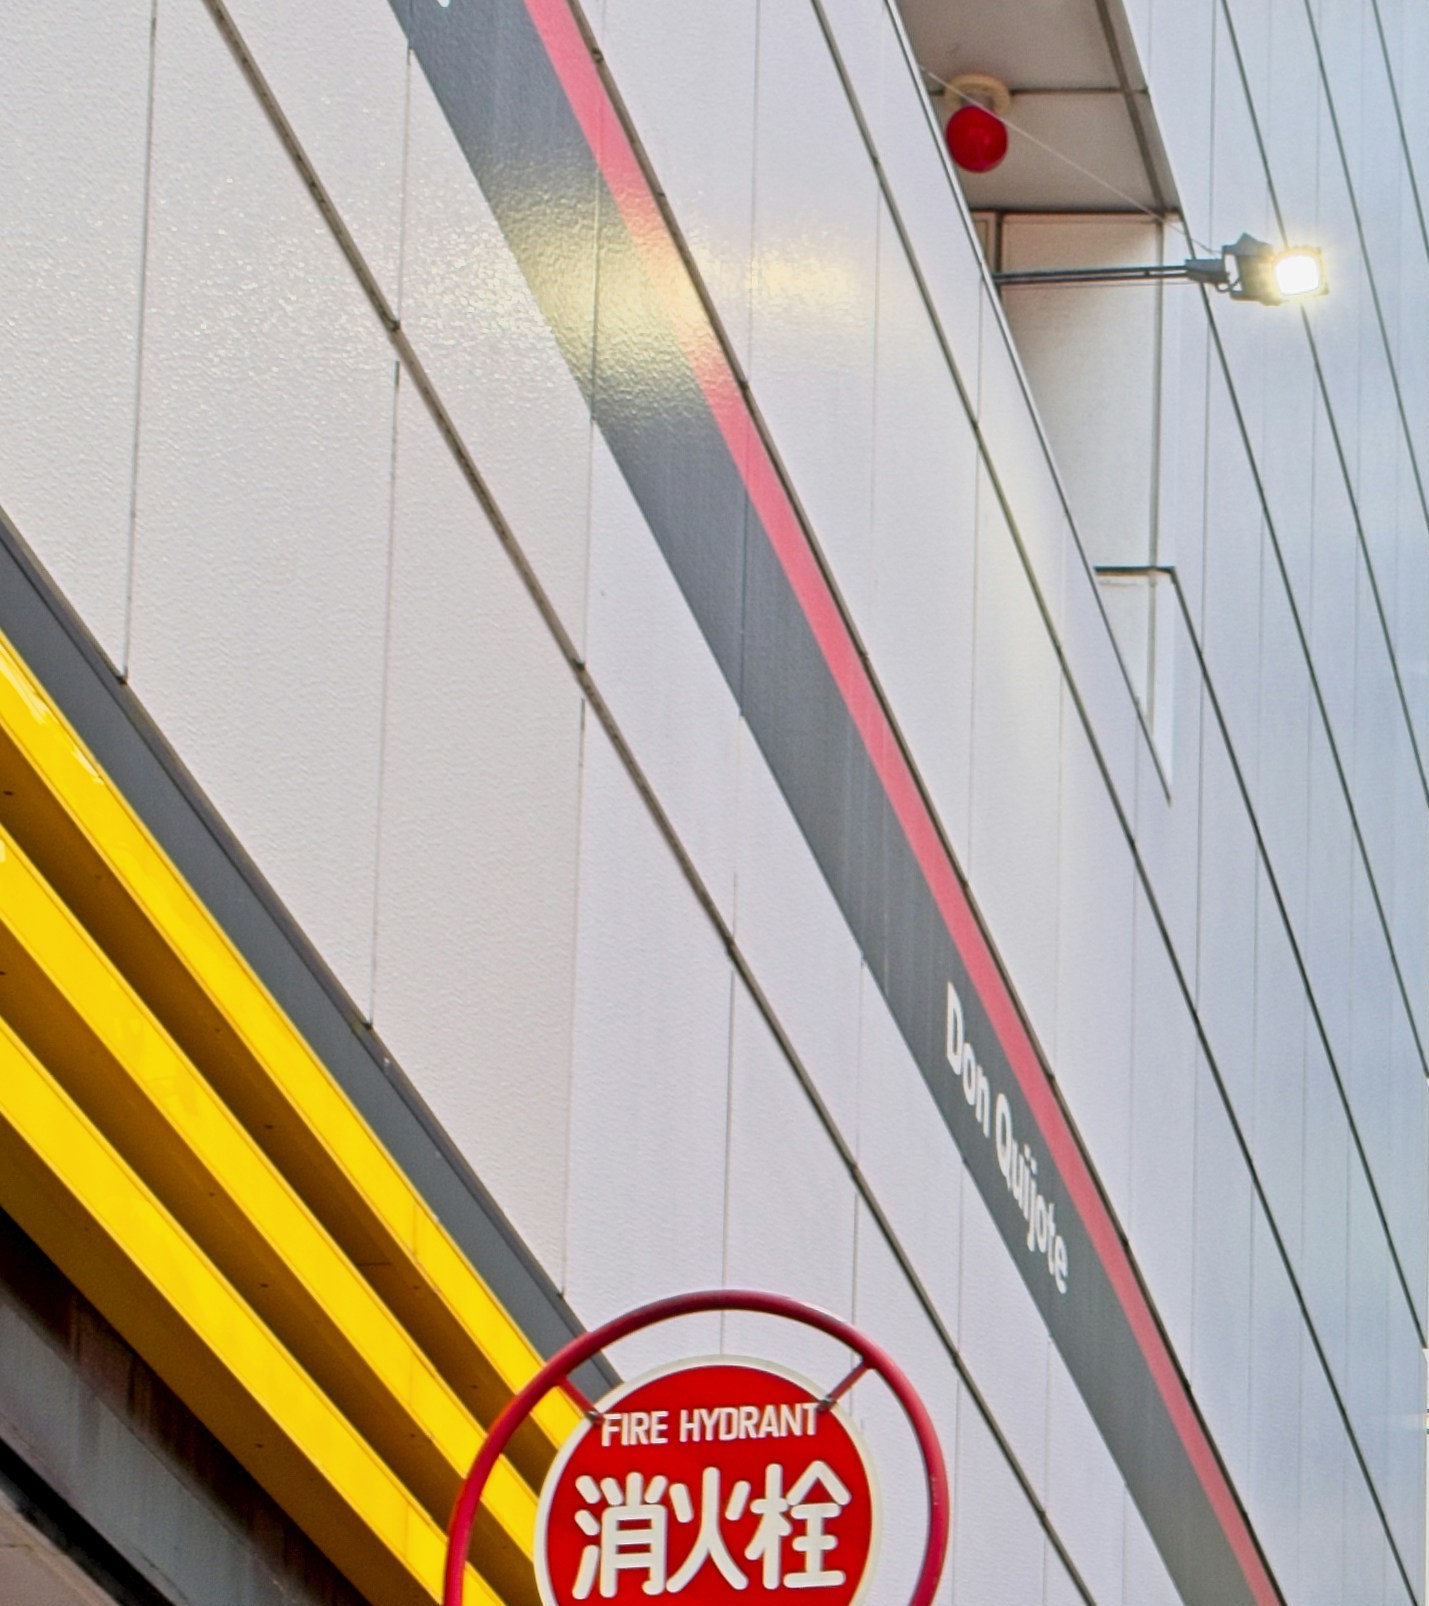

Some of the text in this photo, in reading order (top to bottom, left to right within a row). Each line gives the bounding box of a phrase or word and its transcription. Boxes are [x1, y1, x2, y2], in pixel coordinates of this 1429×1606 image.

[947, 981, 1069, 1295] Don Quijote
[601, 1402, 819, 1447] FIRE HYDRANT
[572, 1460, 851, 1599] 消火栓
